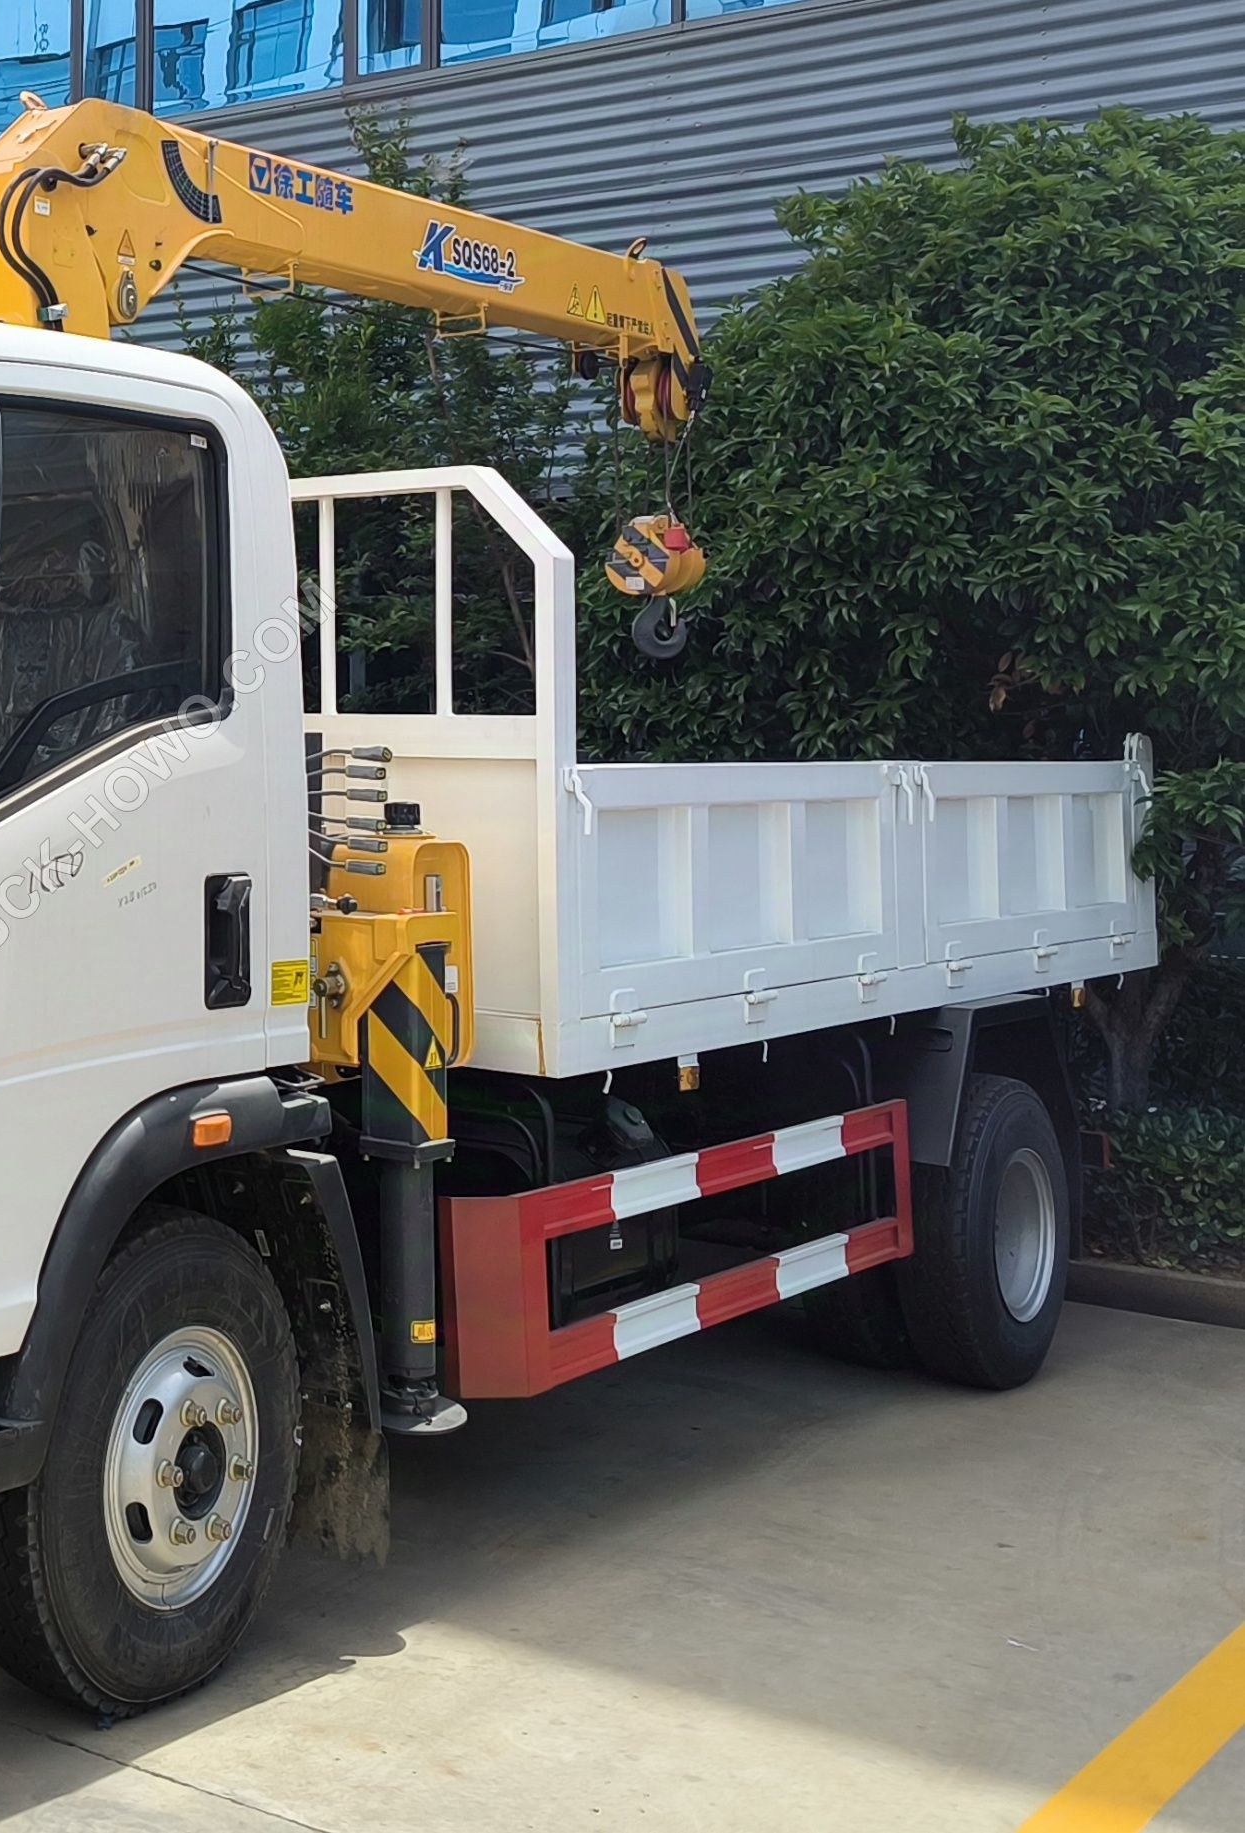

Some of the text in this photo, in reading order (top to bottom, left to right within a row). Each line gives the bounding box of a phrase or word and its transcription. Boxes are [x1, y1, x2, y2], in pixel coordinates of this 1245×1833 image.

[274, 163, 354, 216] 徐工随车
[452, 237, 515, 278] SQS68-2
